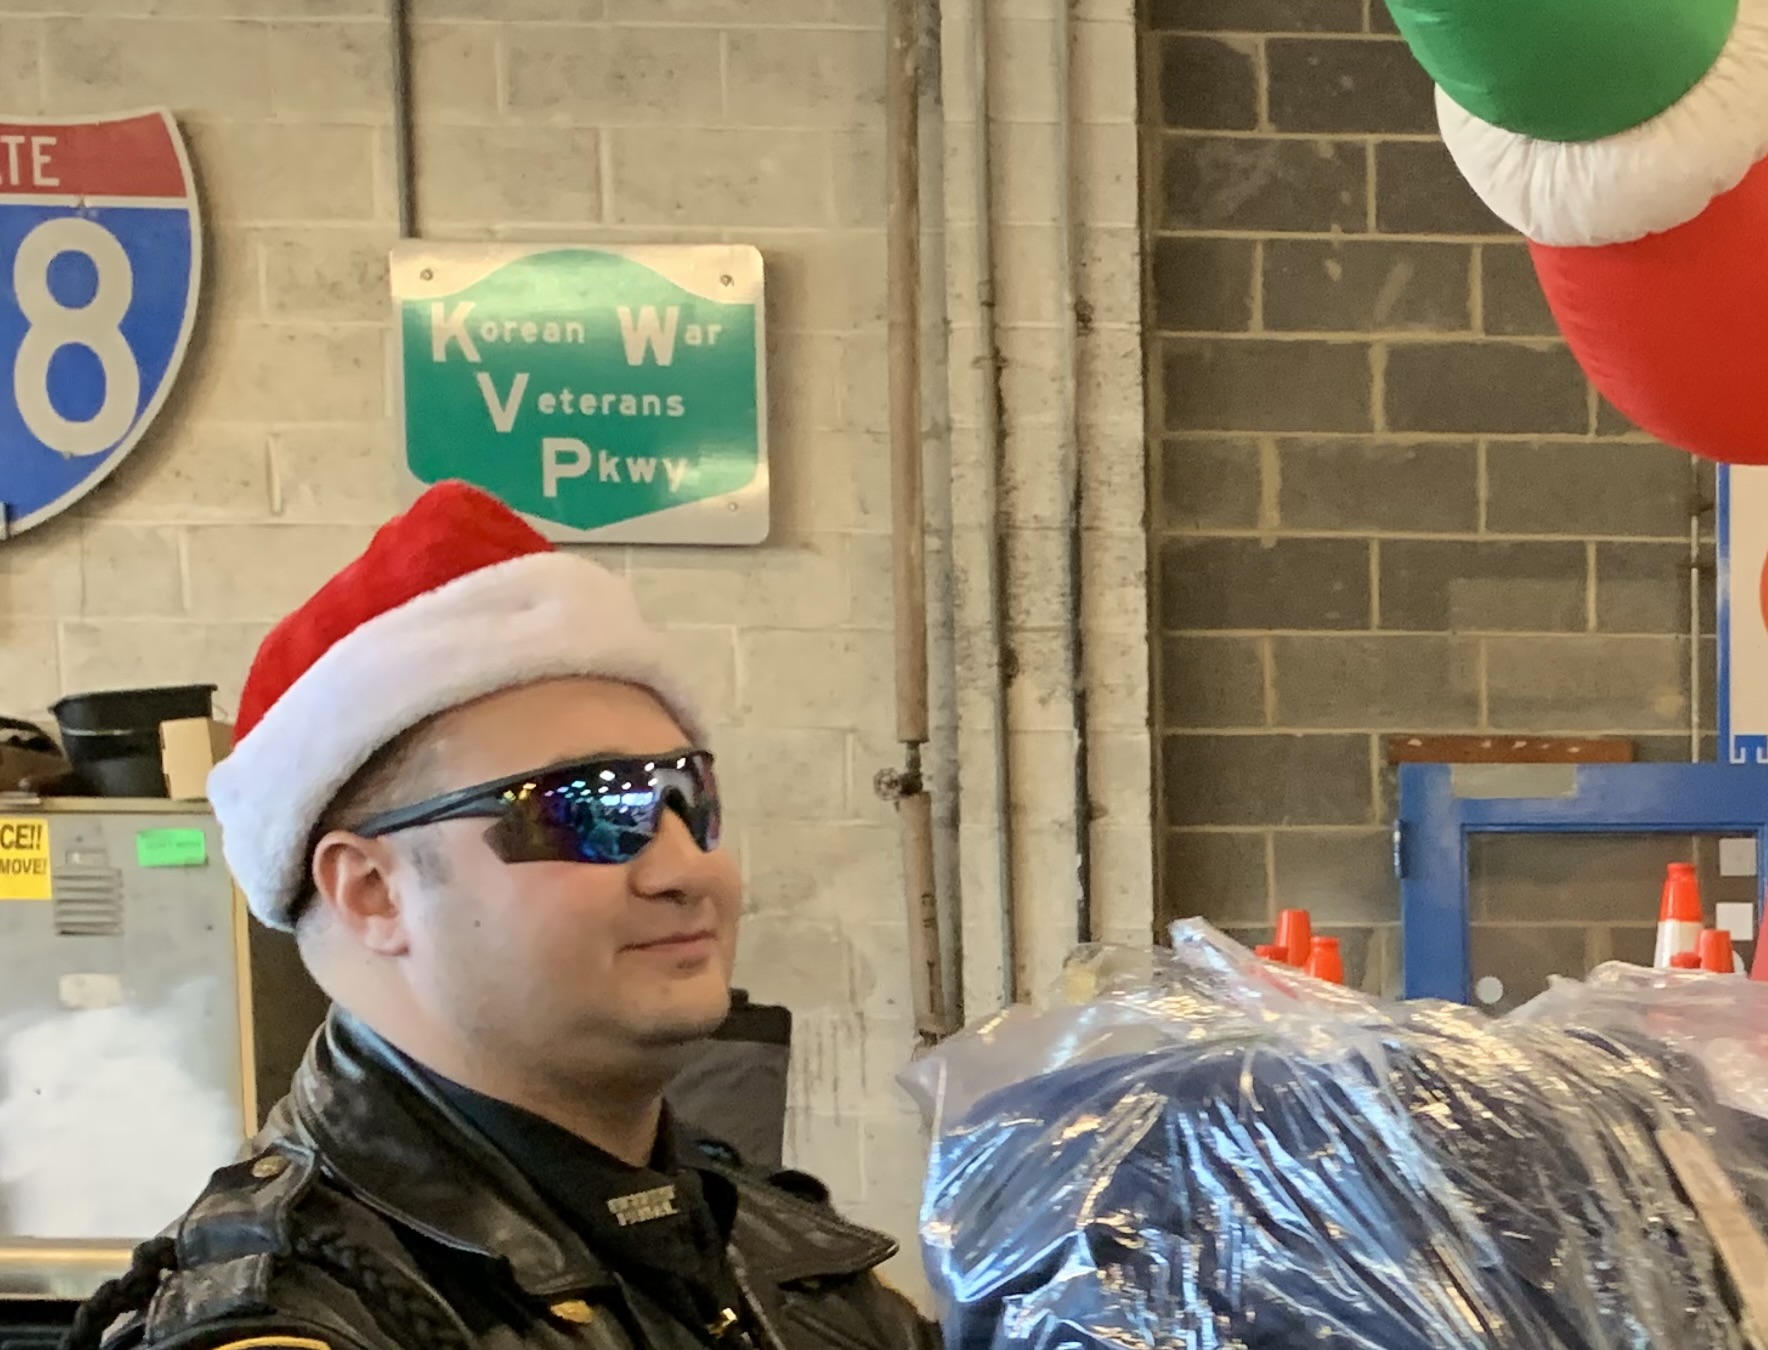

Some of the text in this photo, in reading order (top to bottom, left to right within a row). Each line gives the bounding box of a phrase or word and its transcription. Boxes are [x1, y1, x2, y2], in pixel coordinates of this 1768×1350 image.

[0, 135, 60, 187] TE
[13, 217, 140, 458] 8
[431, 301, 722, 366] Korean War
[476, 372, 686, 433] Veterans
[541, 437, 688, 498] Pkwy
